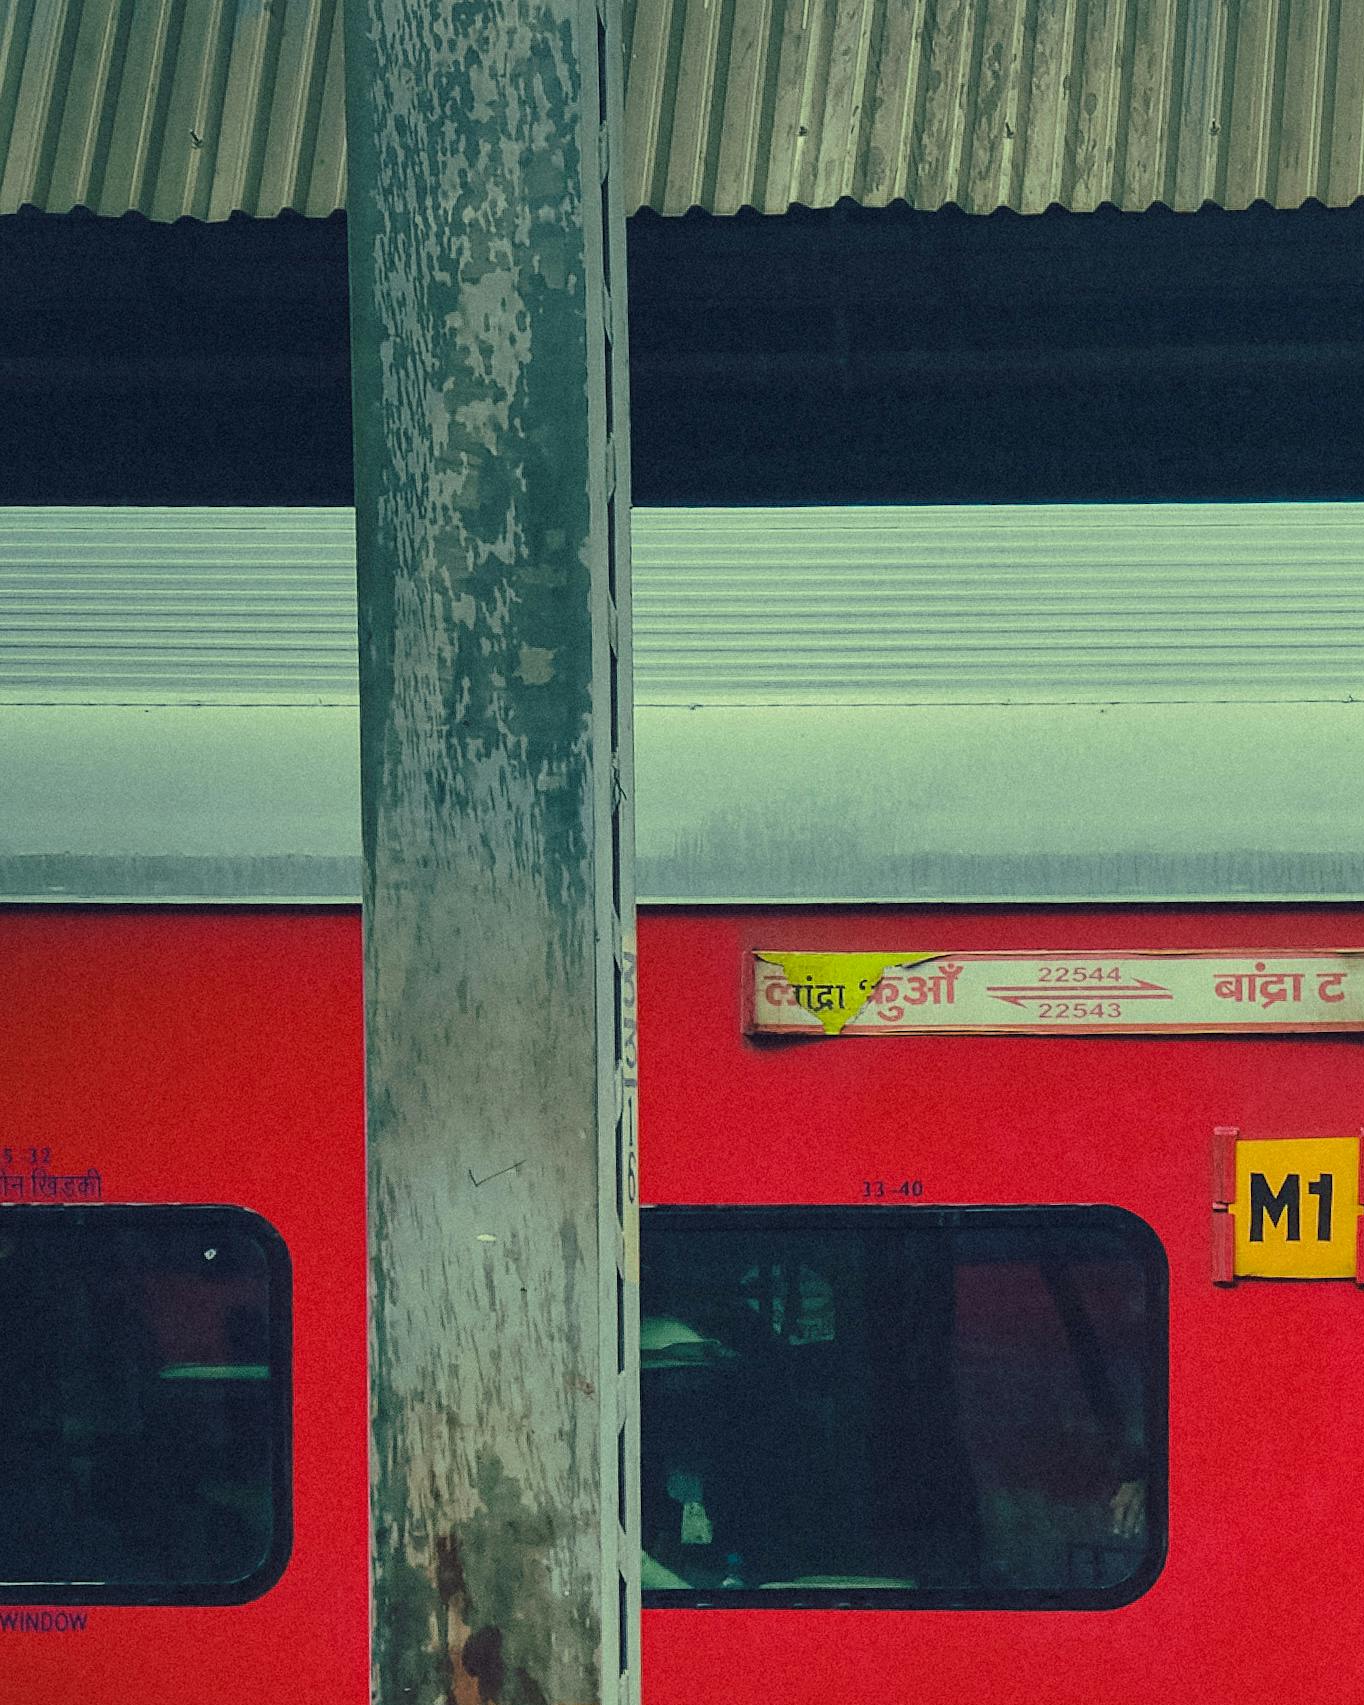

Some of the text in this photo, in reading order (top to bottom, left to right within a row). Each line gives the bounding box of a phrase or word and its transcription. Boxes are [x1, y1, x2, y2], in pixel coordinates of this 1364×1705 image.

[1038, 967, 1122, 982] 22544
[1213, 961, 1347, 1009] बांद्रा ट
[1039, 1003, 1121, 1018] 22543
[1249, 1173, 1333, 1241] M1
[0, 1611, 88, 1632] WINDOW
